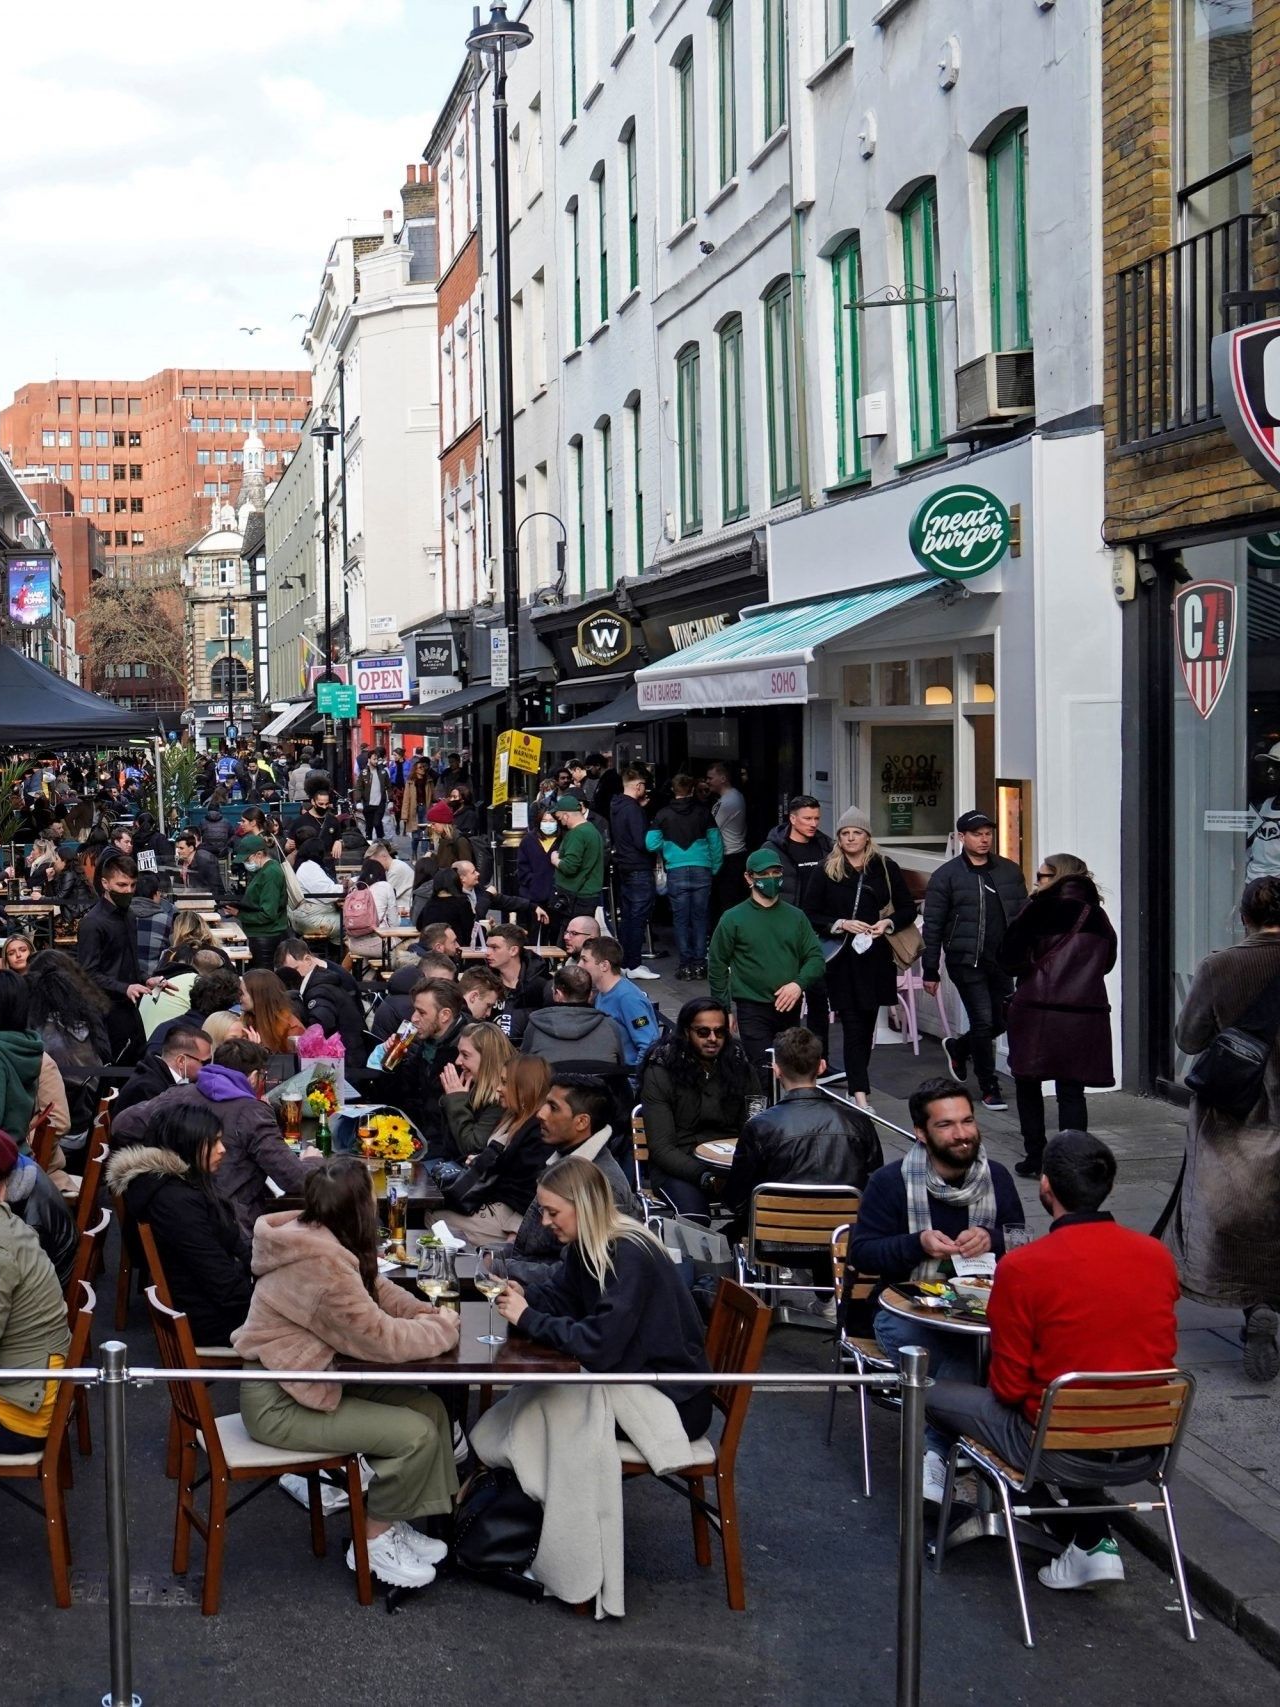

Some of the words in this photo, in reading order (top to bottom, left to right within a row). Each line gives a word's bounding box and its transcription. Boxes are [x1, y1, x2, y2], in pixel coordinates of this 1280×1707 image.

[929, 503, 996, 535] neat
[921, 522, 1004, 558] burger
[590, 618, 621, 627] AUTHENTIC
[590, 628, 620, 648] W
[358, 670, 403, 691] OPEN
[771, 671, 796, 694] SOHO
[642, 684, 658, 701] NEAT
[658, 682, 682, 700] BURGER
[513, 748, 538, 761] WARNING
